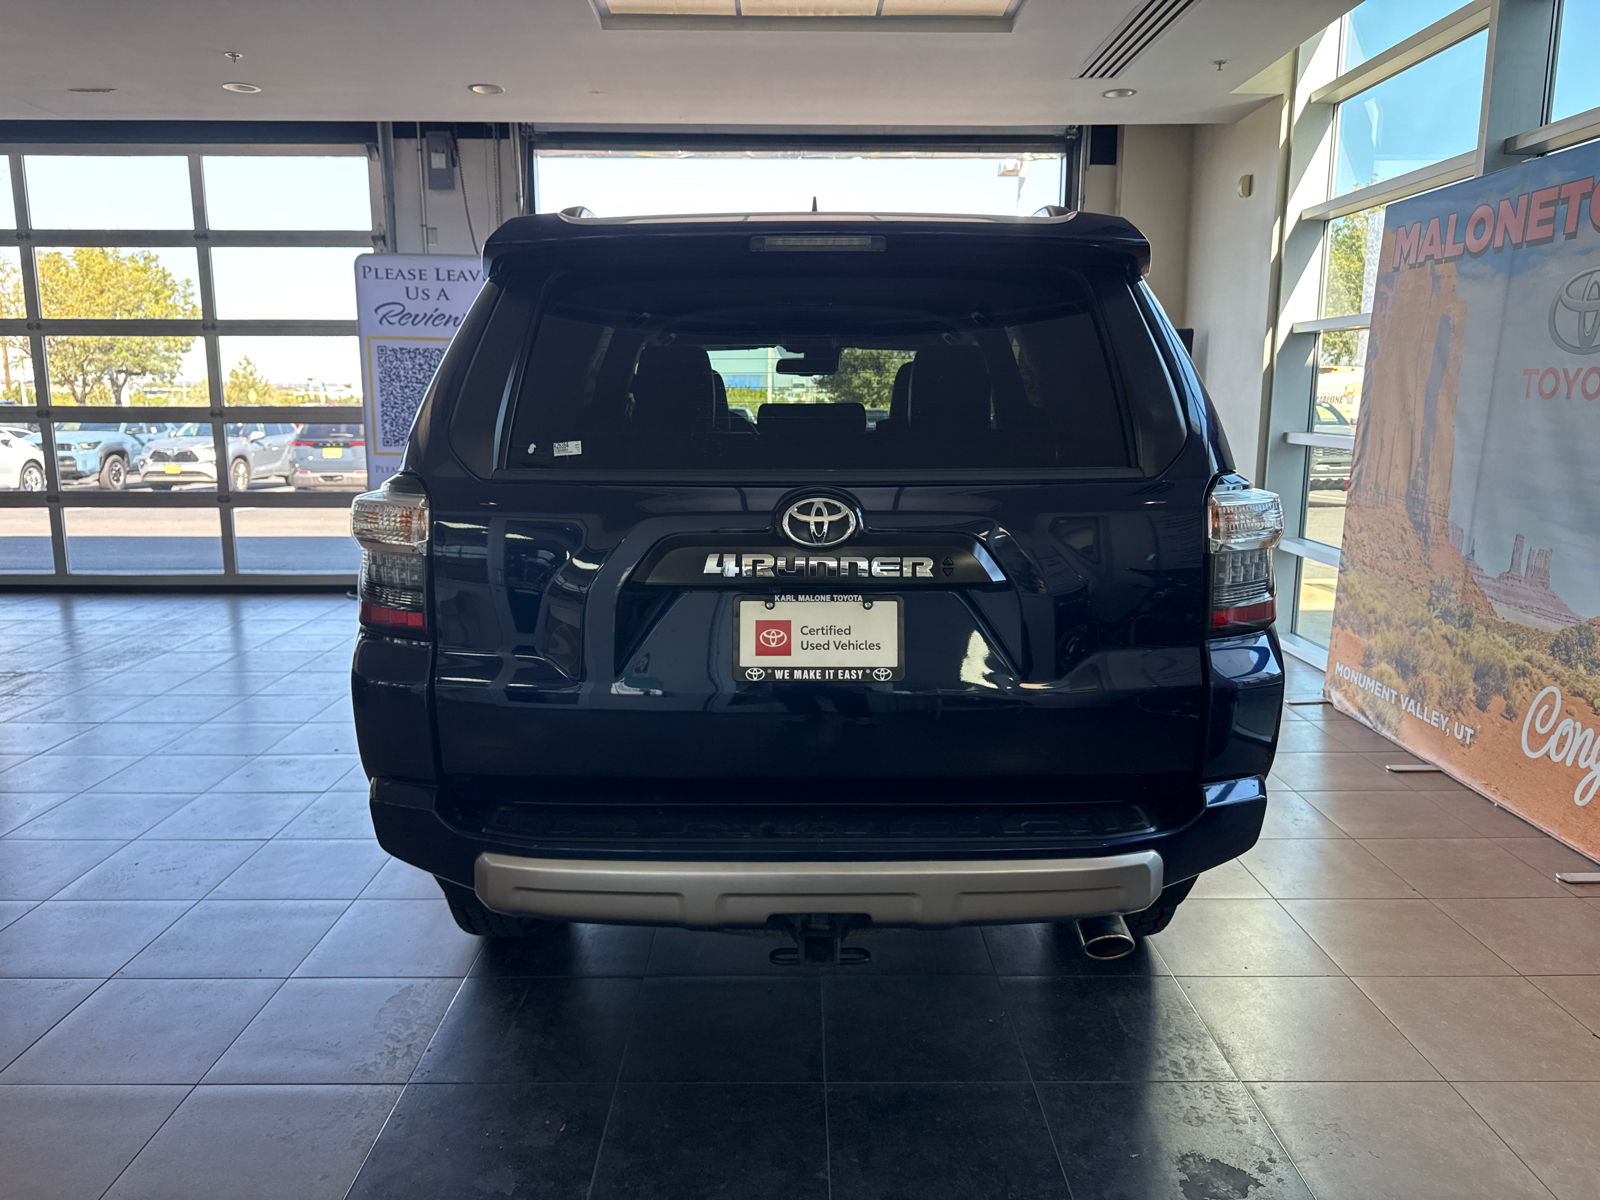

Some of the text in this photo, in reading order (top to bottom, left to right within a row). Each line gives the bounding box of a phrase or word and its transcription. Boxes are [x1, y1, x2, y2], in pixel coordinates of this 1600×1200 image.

[361, 265, 485, 282] PLEASE LEAV
[404, 286, 451, 301] US A
[1523, 366, 1600, 401] TOYO
[703, 553, 934, 577] 4RUNNER
[774, 594, 863, 602] KARL MALONE TOYOTA
[800, 625, 852, 636] Certified
[800, 640, 881, 651] Used Vehicles
[774, 669, 863, 680] WE MAKE IT EASY
[1335, 661, 1475, 745] MONUMENT VALLEY, UT
